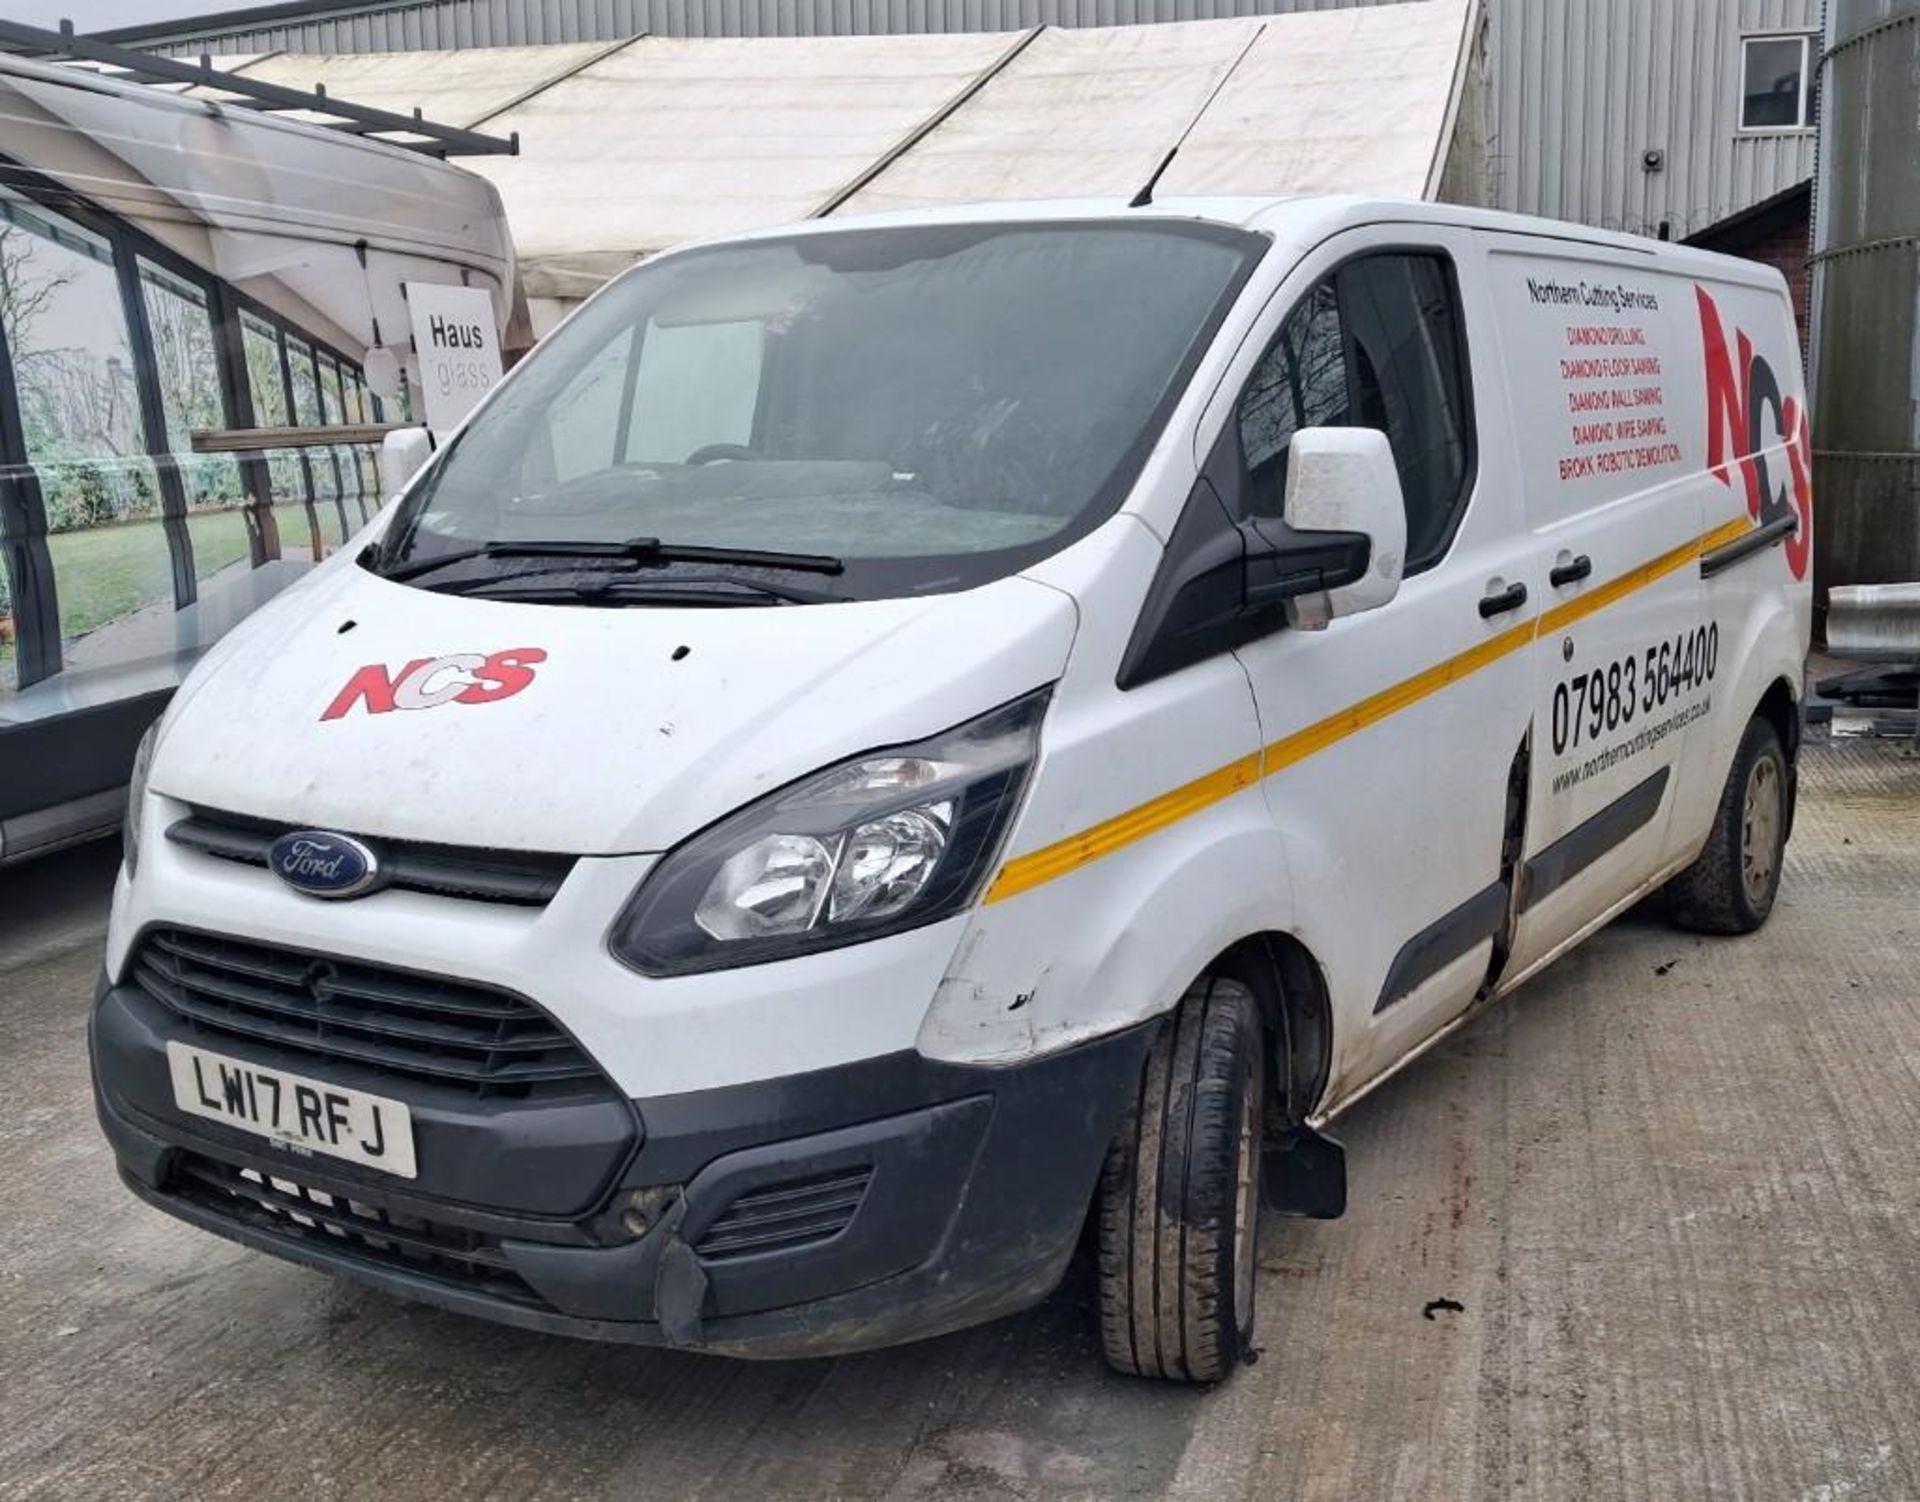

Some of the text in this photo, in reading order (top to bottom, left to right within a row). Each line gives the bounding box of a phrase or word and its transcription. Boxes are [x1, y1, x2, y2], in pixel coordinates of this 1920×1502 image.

[1527, 277, 1659, 313] Northern Cutting Services
[430, 314, 483, 348] Haus
[1566, 327, 1646, 345] DIAMOND DRILLING
[437, 353, 490, 396] glass
[1560, 359, 1600, 379] DIAMOND
[1601, 358, 1630, 377] FLOOR
[1569, 391, 1610, 412] DIAMOND
[1573, 422, 1613, 445] DIAMOND
[1597, 449, 1635, 473] ROBOTIC
[318, 647, 548, 721] NCS
[1552, 620, 1719, 756] 07983 564400
[1552, 694, 1711, 794] www.northerncuttingservices.co.uk
[282, 840, 344, 879] Ford
[193, 1056, 385, 1157] LW17 RFJ
